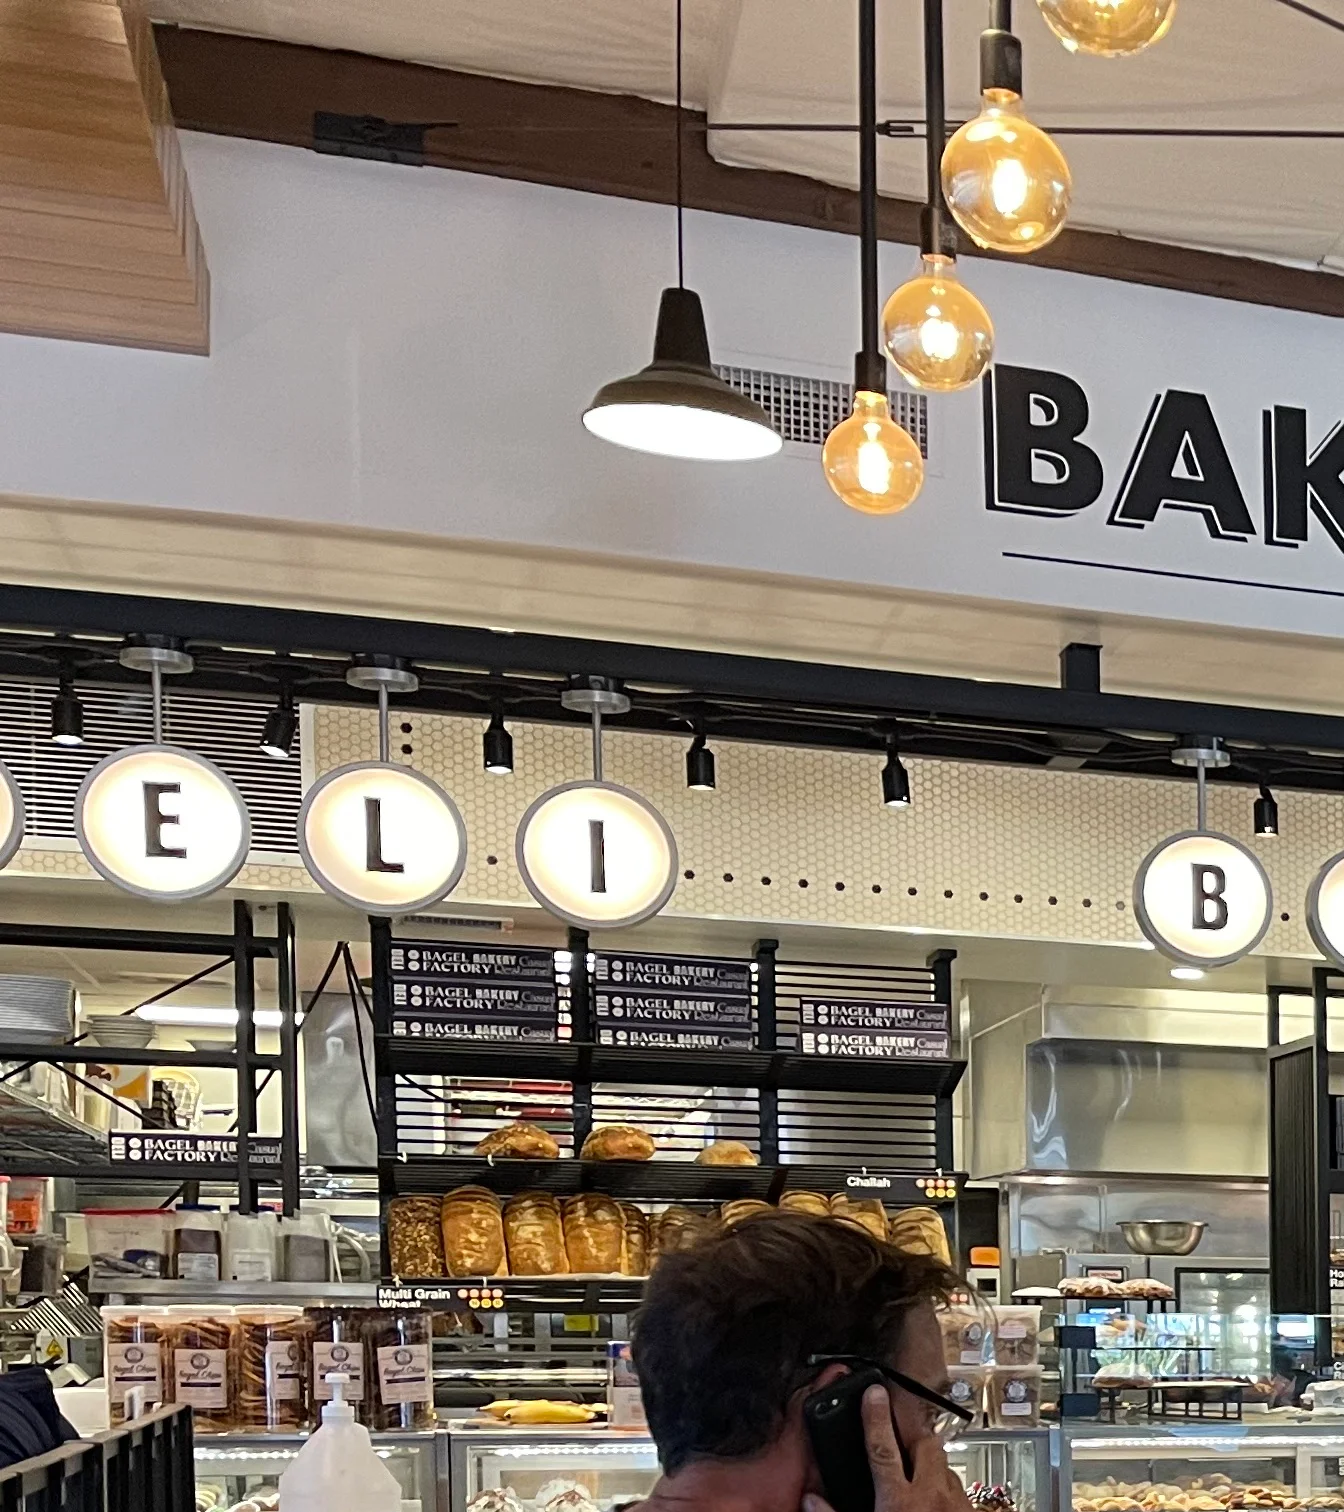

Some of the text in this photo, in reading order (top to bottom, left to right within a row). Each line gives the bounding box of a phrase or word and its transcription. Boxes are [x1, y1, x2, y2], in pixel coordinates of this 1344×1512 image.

[423, 951, 469, 963] BAGEL
[473, 953, 516, 965] BAKERY
[423, 962, 491, 974] FACTORY
[626, 961, 670, 973] BAGEL
[674, 965, 715, 977] BAKERY
[626, 973, 691, 985] FACTORY
[425, 986, 472, 998] BAGEL
[476, 988, 519, 1000] BAKERY
[425, 997, 494, 1009] FACTORY
[626, 998, 670, 1009] BAGEL
[674, 1000, 715, 1012] BAKERY
[626, 1008, 691, 1020] FACTORY
[831, 1005, 872, 1016] BAGEL
[876, 1008, 914, 1018] BAKERY
[831, 1016, 892, 1027] FACTORY
[425, 1023, 472, 1034] BAGEL
[475, 1024, 518, 1036] BAKERY
[630, 1031, 674, 1042] BAGEL
[678, 1034, 719, 1044] BAKERY
[831, 1034, 873, 1045] BAGEL
[876, 1036, 915, 1047] BAKERY
[831, 1044, 893, 1056] FACTORY
[145, 1139, 194, 1150] BAGEL
[197, 1140, 238, 1151] BAKER
[145, 1151, 217, 1162] FACTORY
[847, 1177, 891, 1188] Challah
[379, 1288, 450, 1300] Multi Grain
[379, 1300, 421, 1308] Wheat
